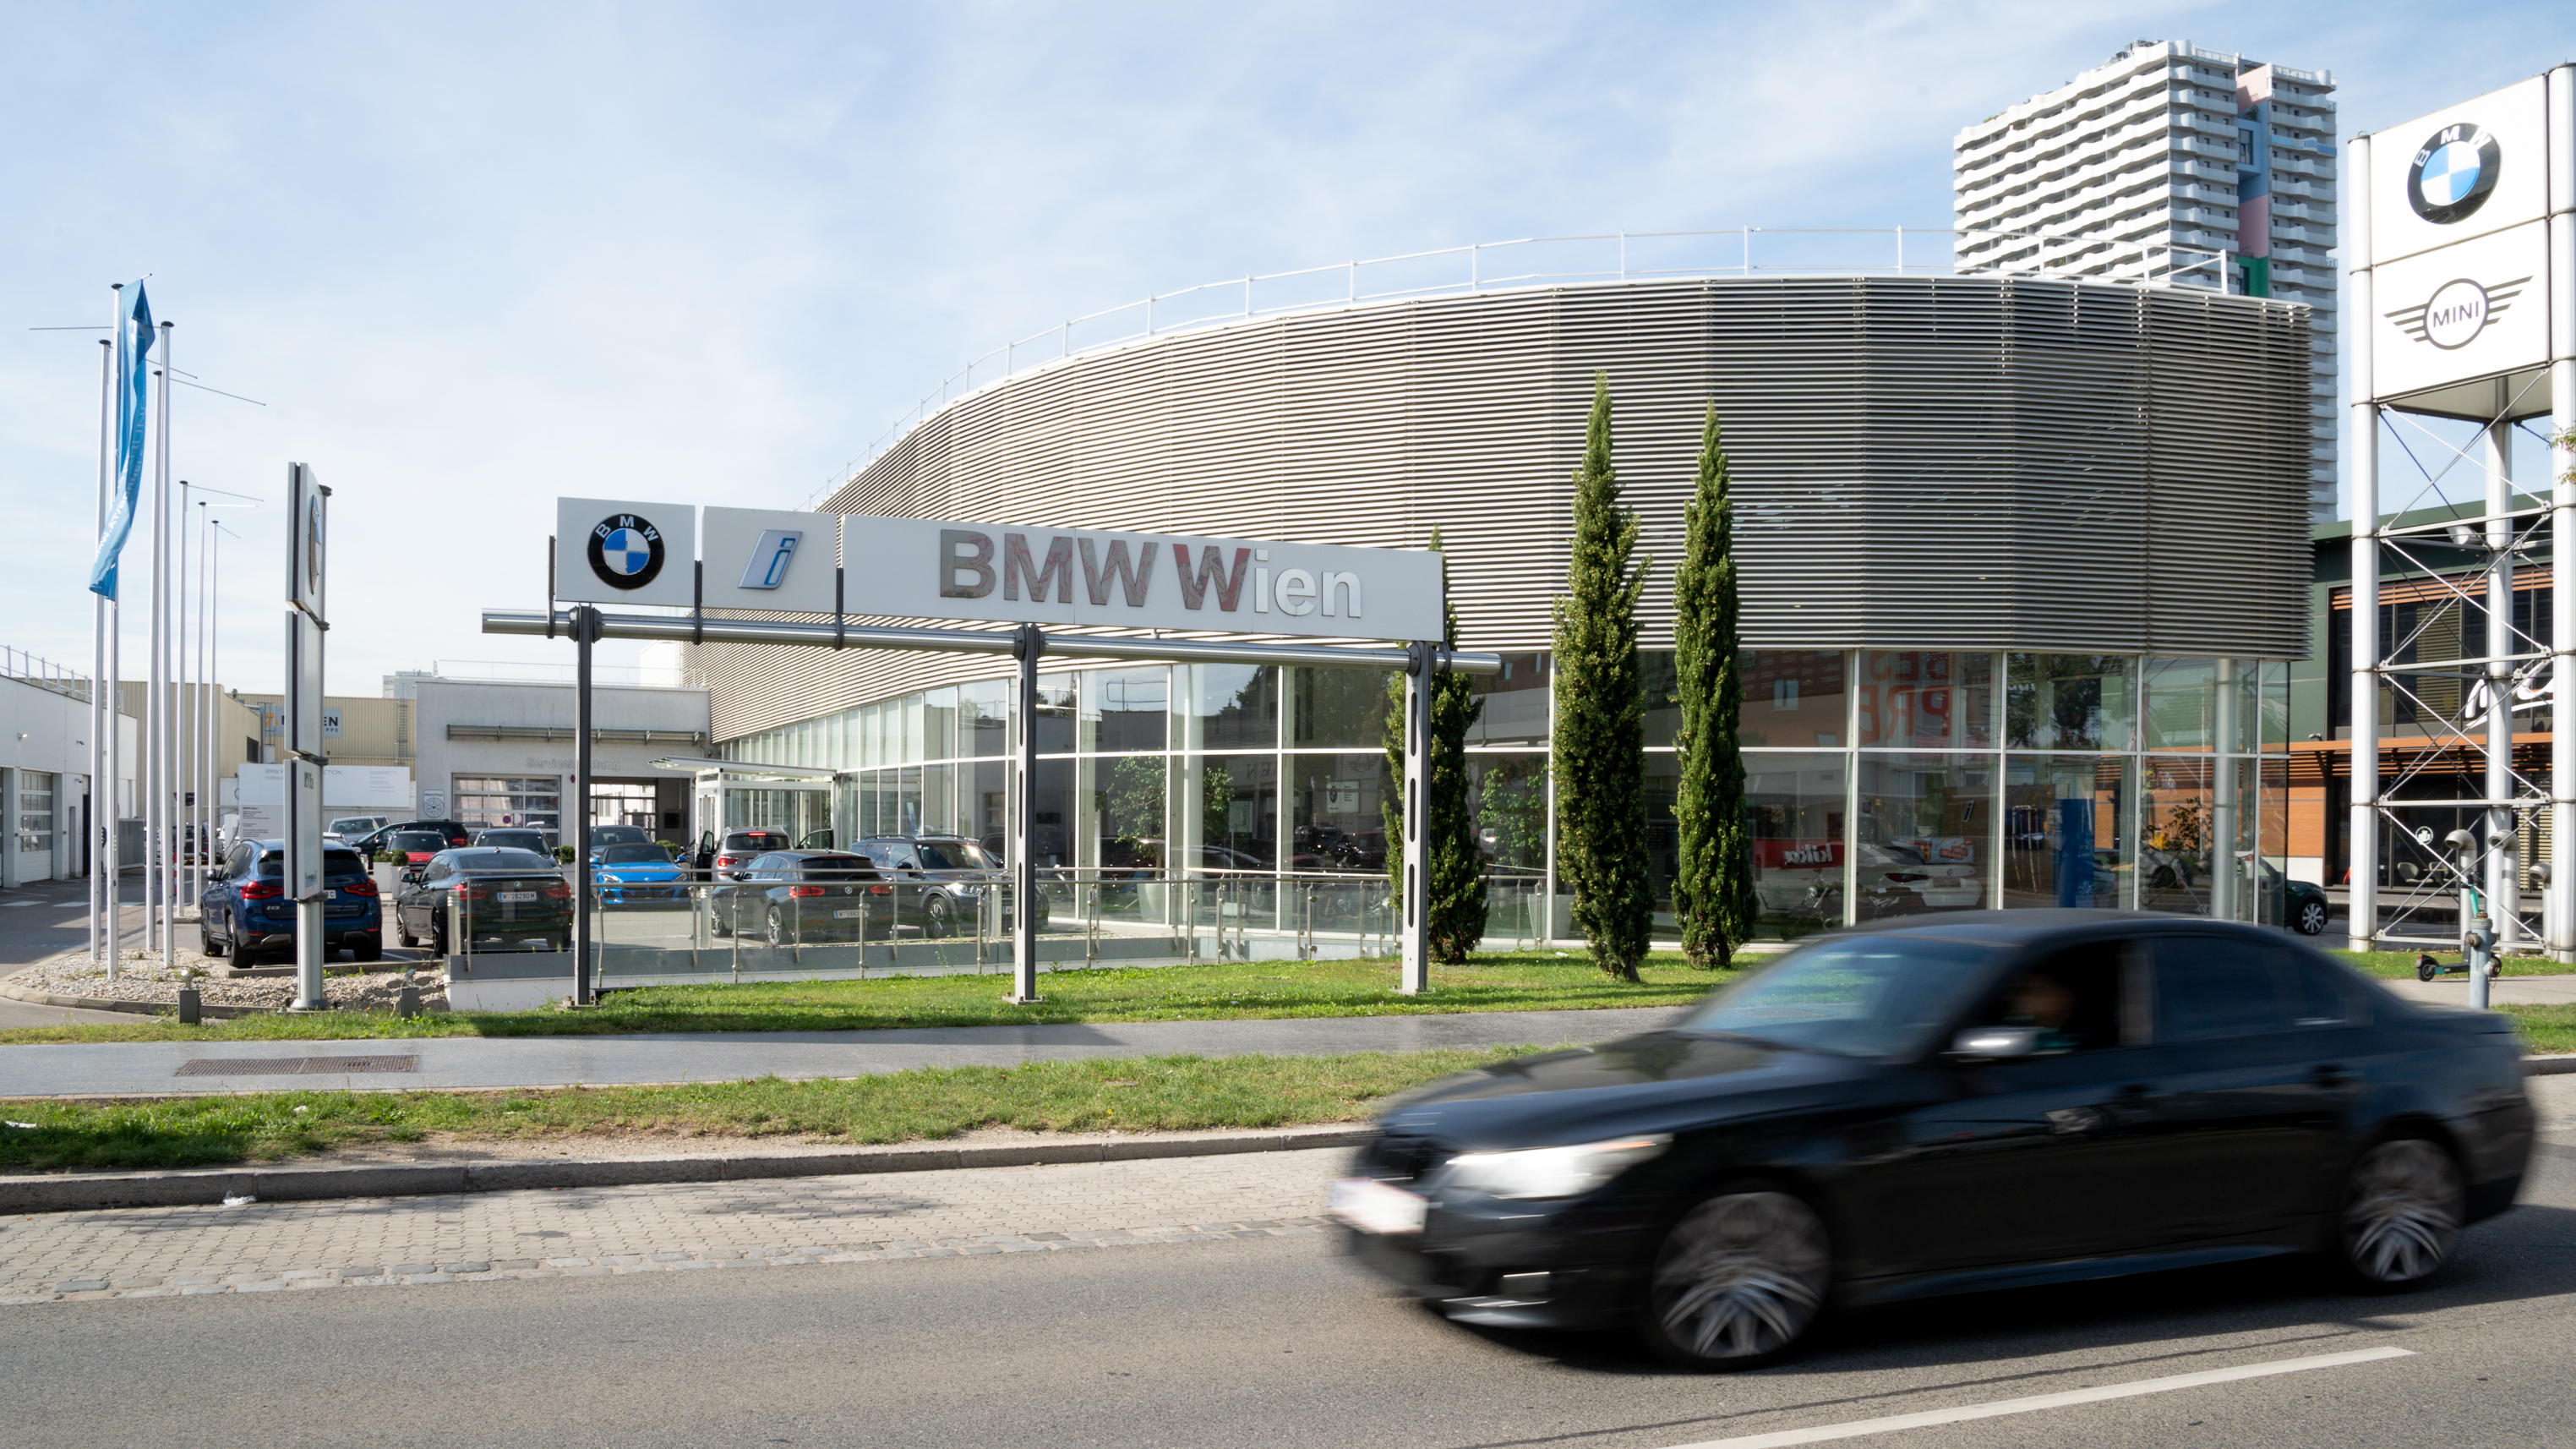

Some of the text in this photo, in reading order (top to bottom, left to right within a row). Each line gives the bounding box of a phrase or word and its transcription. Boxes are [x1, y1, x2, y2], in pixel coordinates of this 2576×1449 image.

[2414, 125, 2492, 167] BMW
[2433, 301, 2479, 328] MINI
[595, 515, 659, 542] BMW
[940, 529, 1362, 618] BMW Wien
